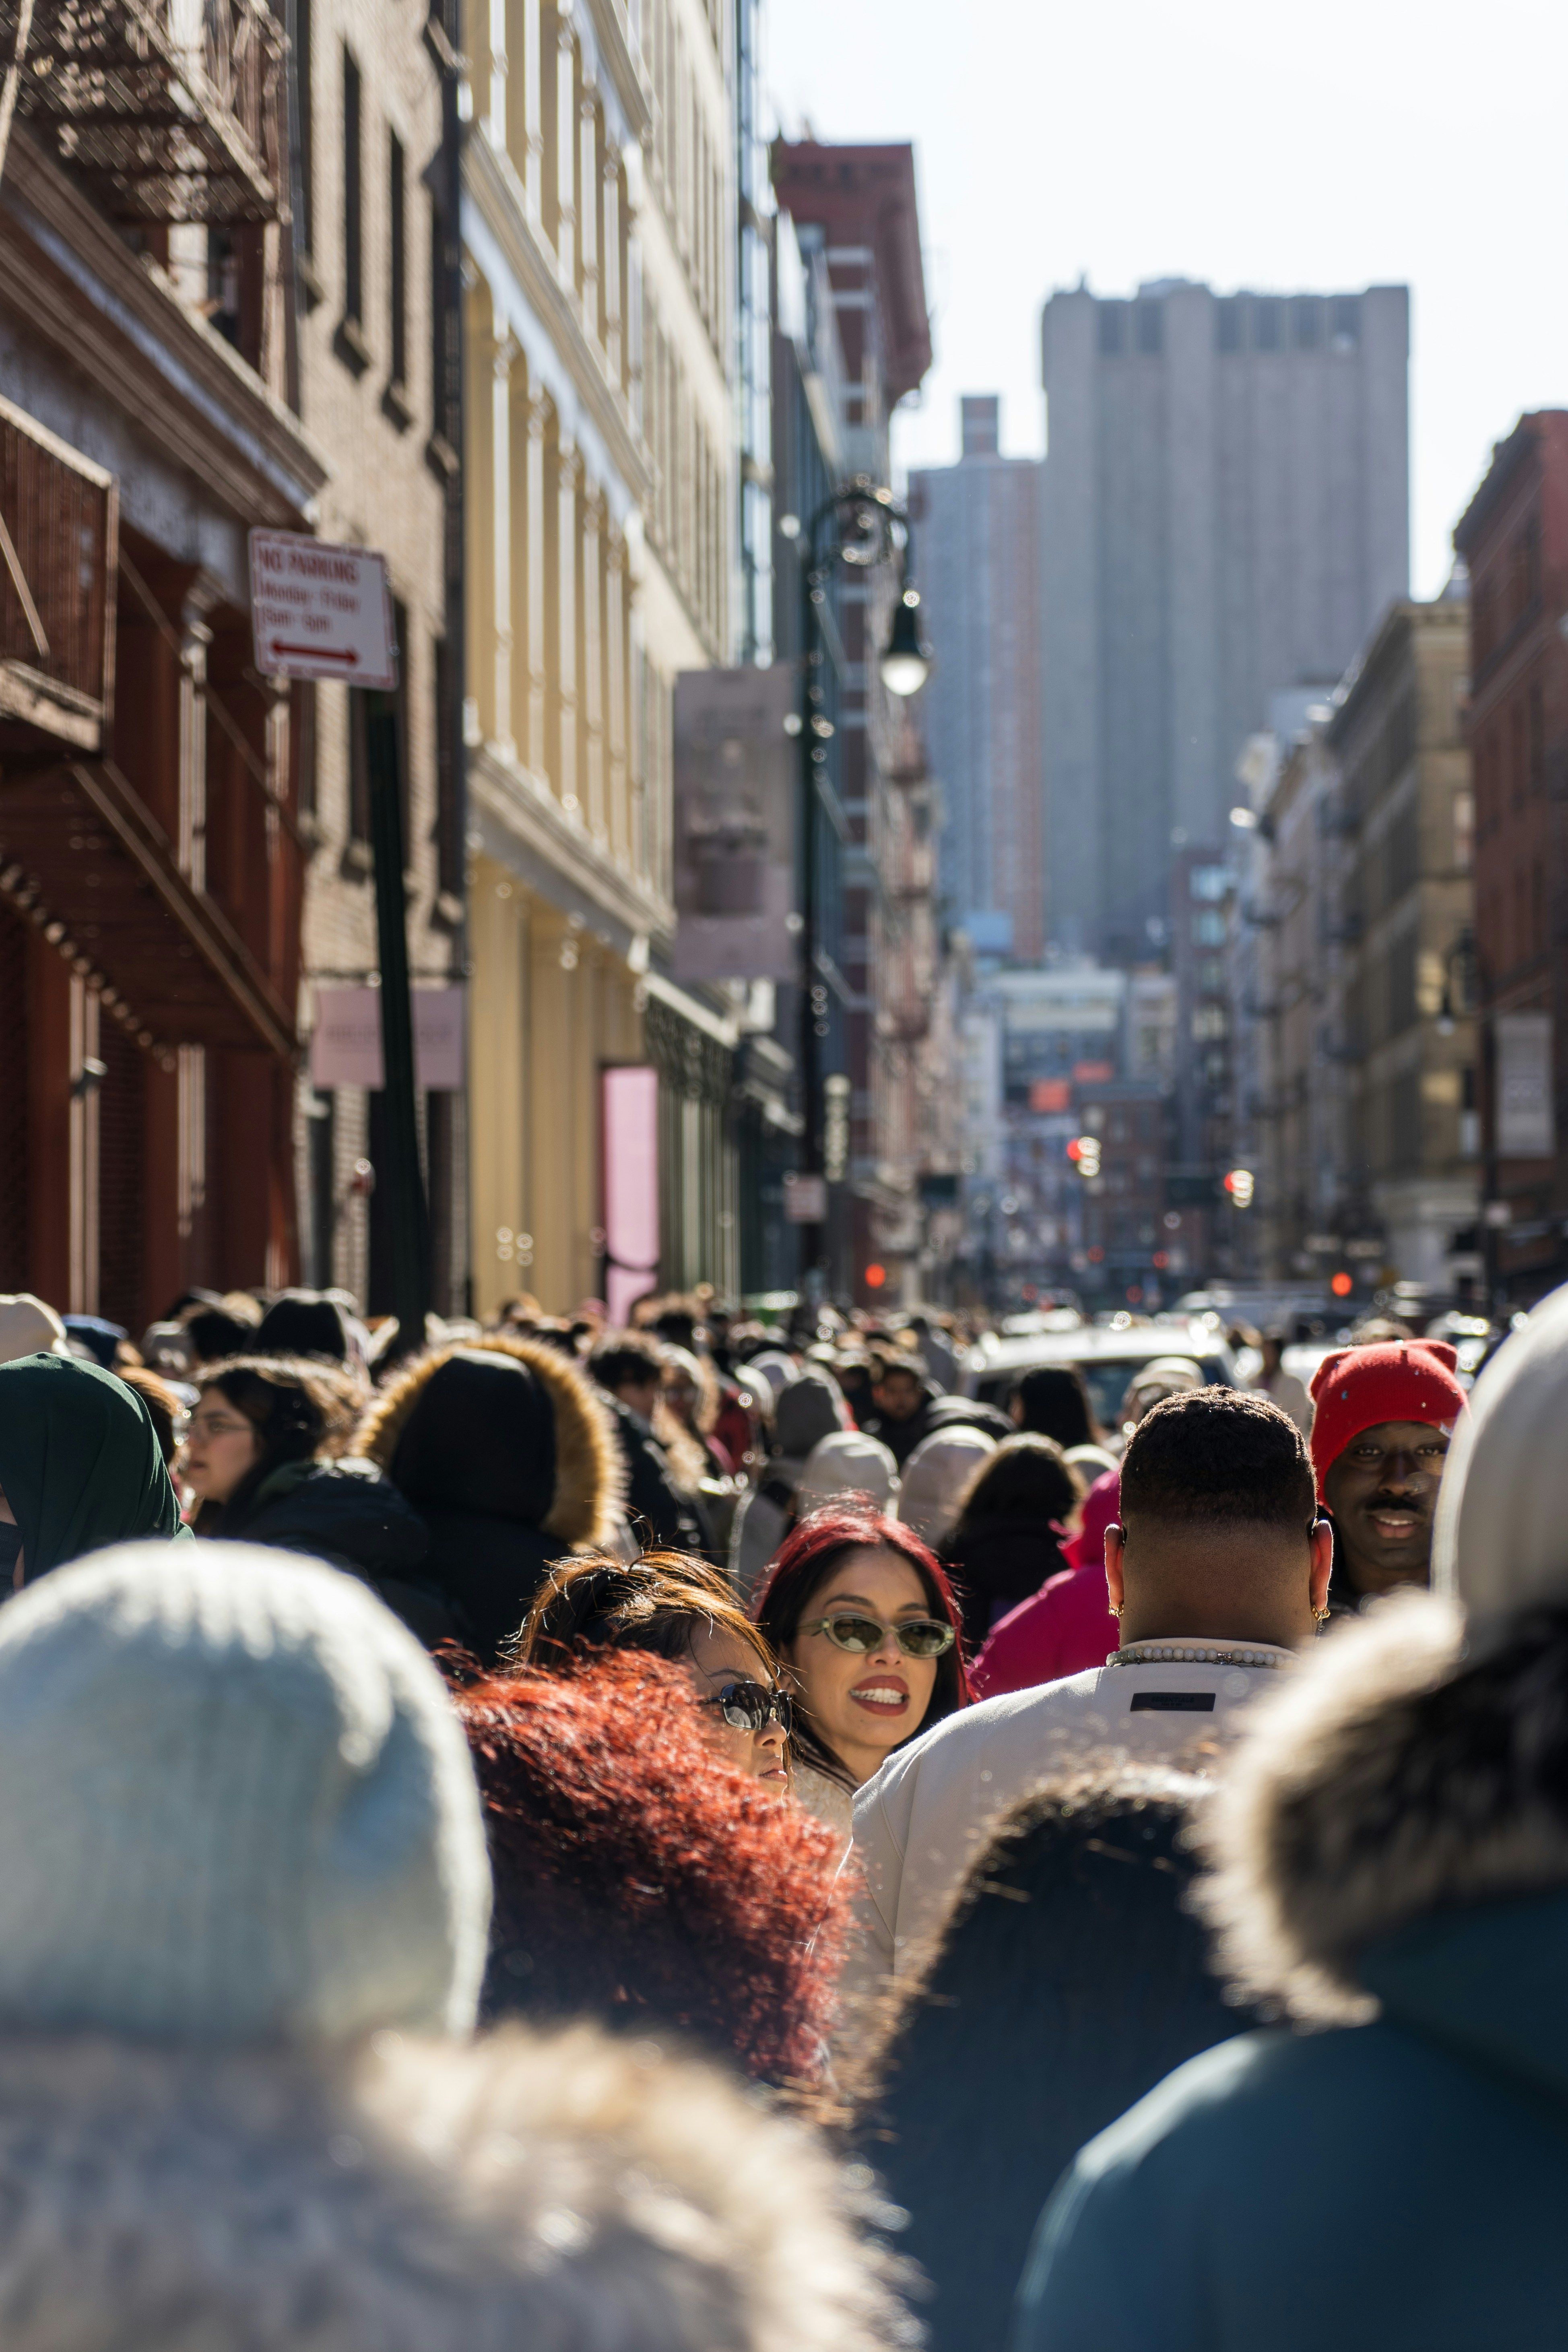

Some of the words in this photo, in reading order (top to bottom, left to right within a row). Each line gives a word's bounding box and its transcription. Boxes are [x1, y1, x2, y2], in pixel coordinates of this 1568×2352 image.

[260, 546, 285, 572] NO
[288, 550, 359, 585] PARKING
[262, 578, 311, 608] Monday
[321, 588, 359, 615] Friday
